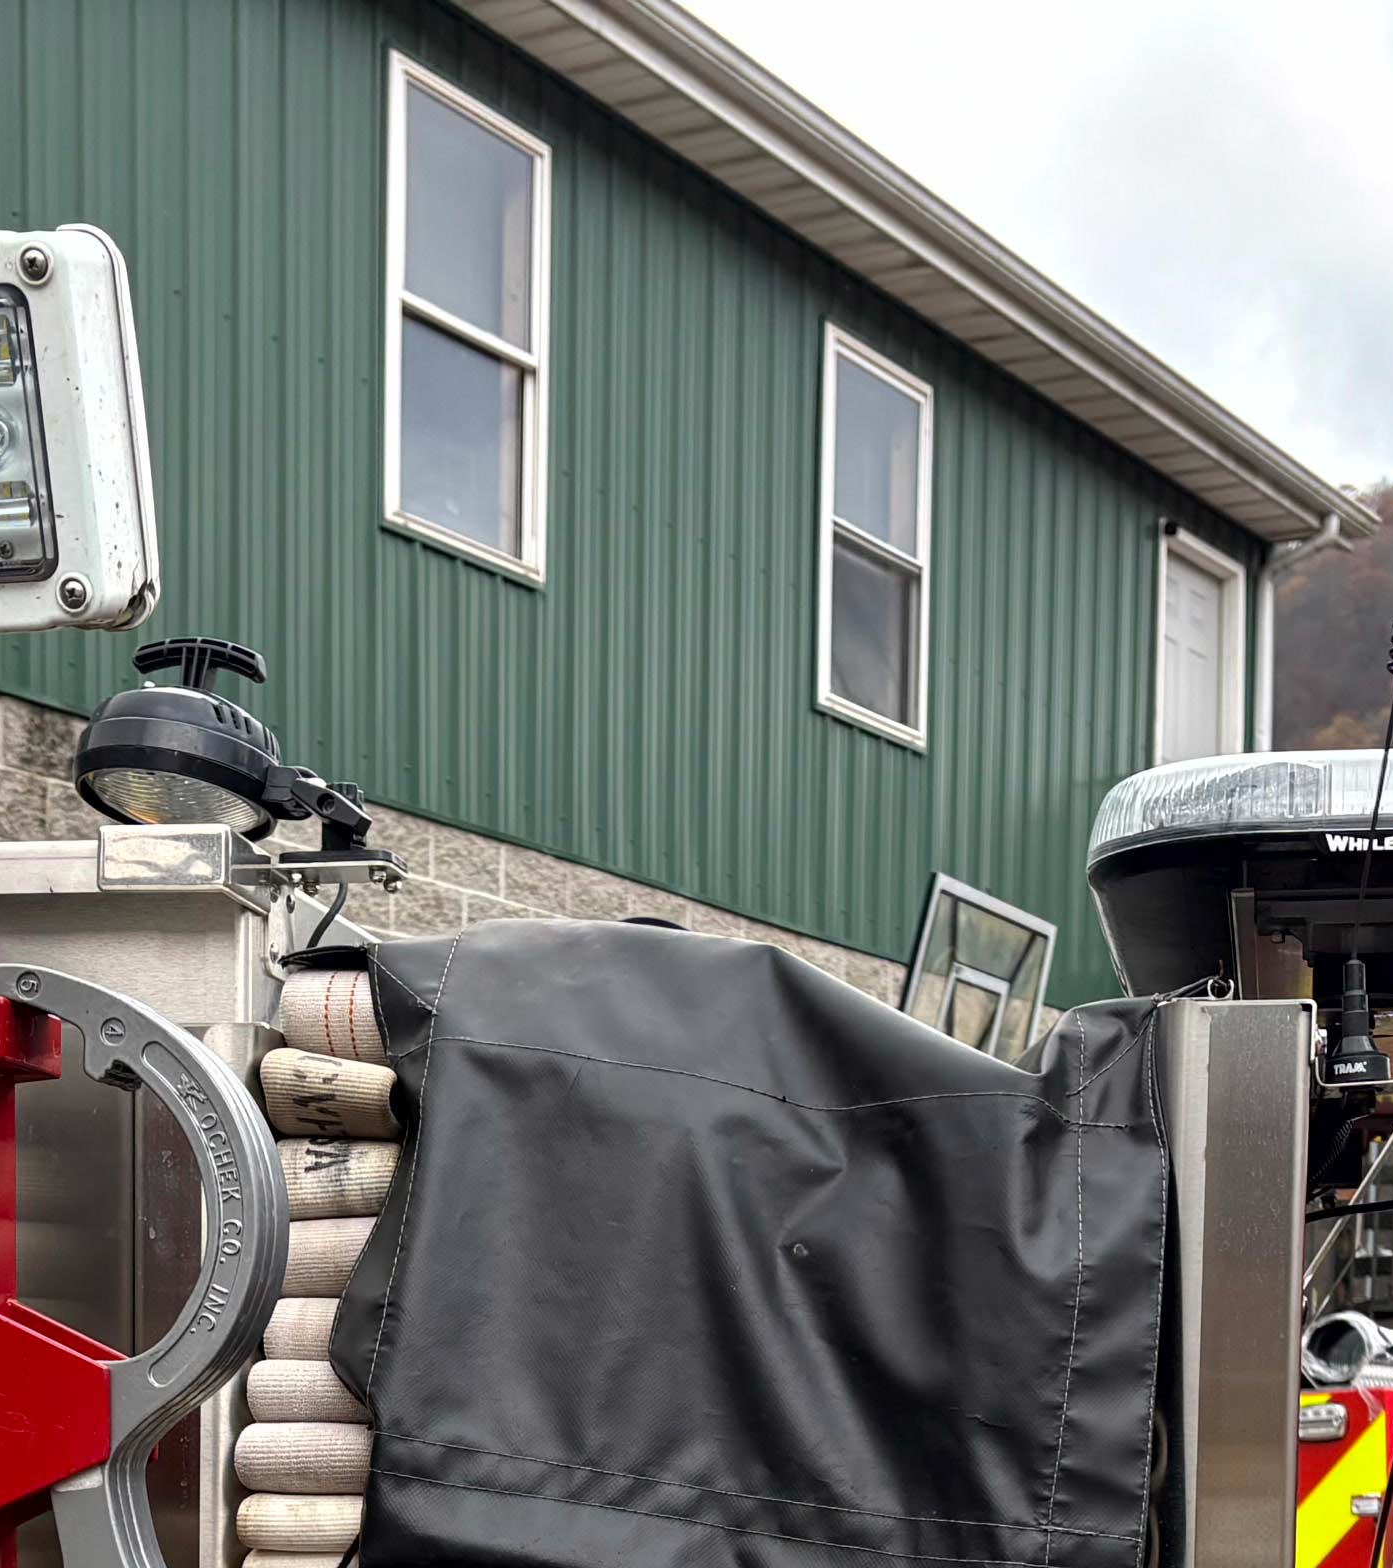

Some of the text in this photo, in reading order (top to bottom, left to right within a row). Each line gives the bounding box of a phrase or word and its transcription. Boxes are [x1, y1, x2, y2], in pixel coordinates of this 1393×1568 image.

[19, 978, 39, 995] 5
[104, 1022, 123, 1039] 4
[219, 1218, 243, 1265] CO.
[190, 1283, 230, 1335] INC.
